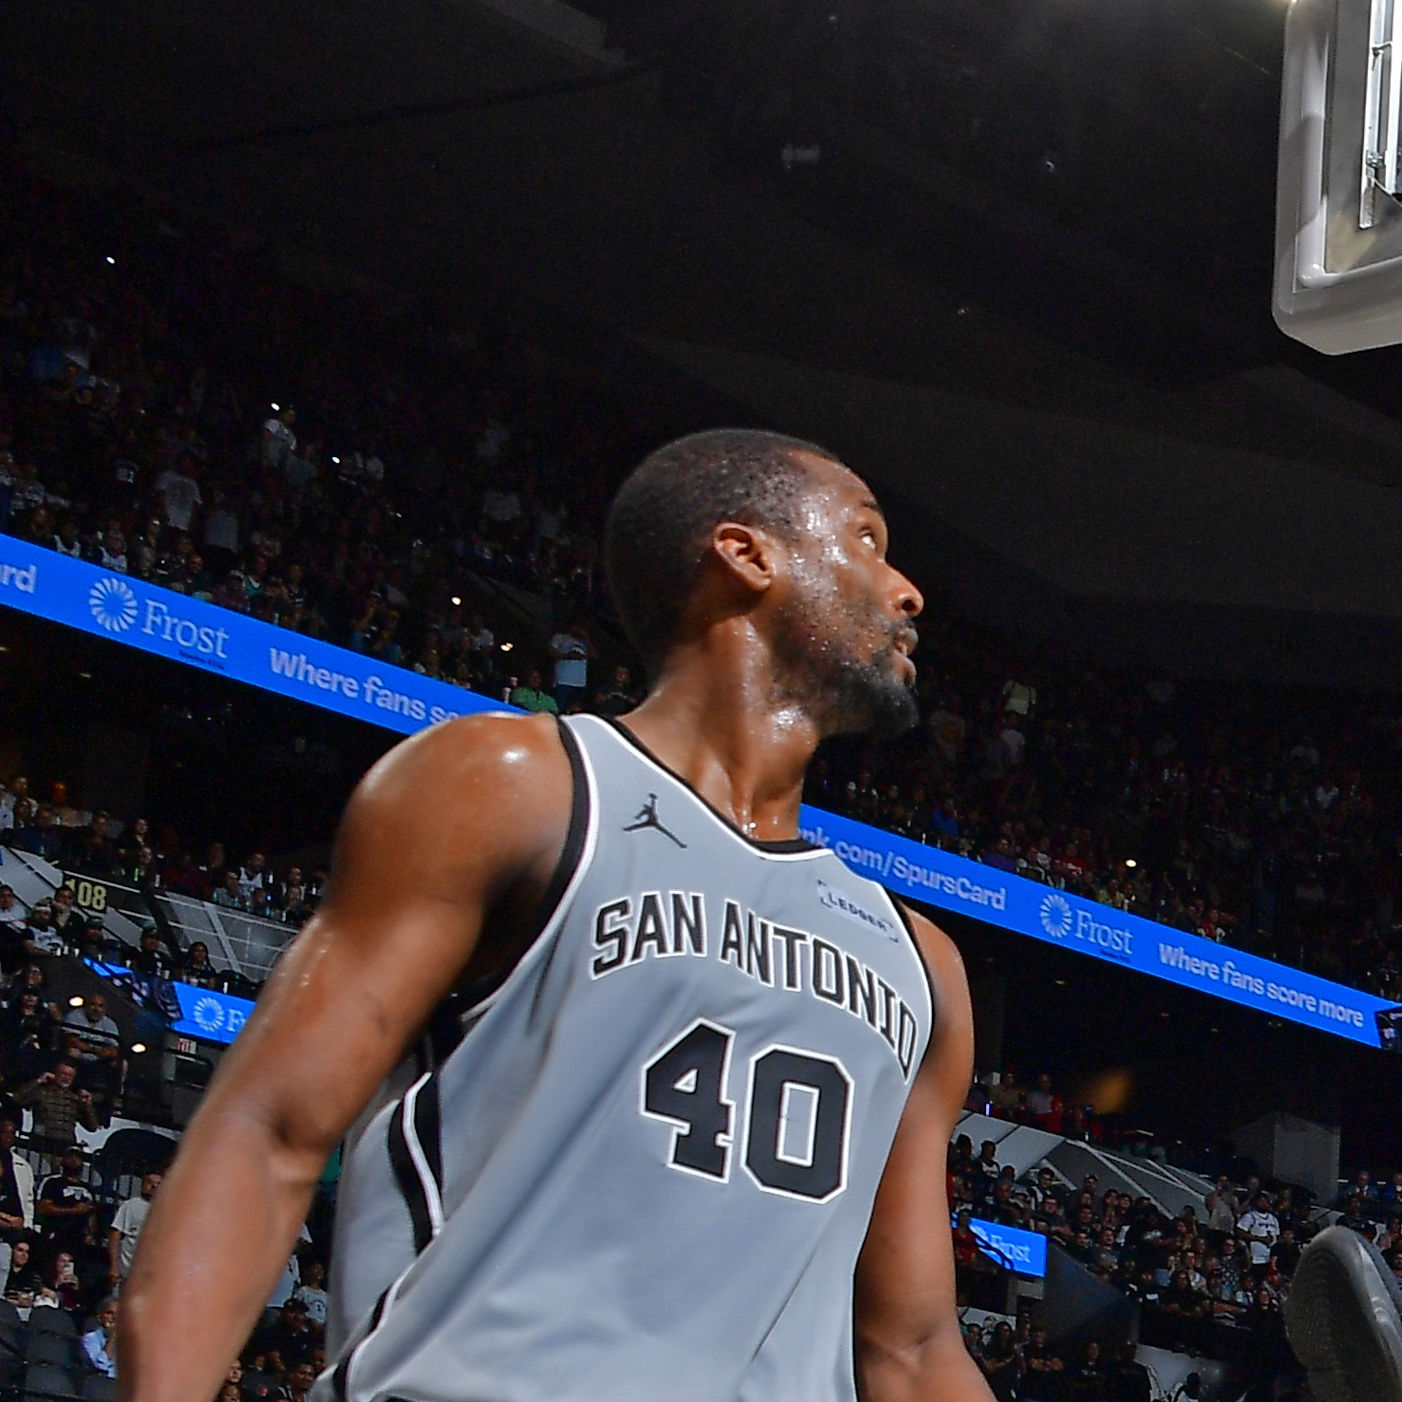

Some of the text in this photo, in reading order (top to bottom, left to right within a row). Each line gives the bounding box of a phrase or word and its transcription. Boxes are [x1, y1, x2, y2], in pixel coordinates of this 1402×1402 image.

[0, 564, 38, 594] rd
[141, 598, 230, 659] Frost
[270, 647, 360, 699] Where
[363, 676, 427, 721] fans
[827, 892, 888, 931] LEDGER
[1075, 909, 1133, 954] Frost
[591, 890, 918, 1085] SAN ANTONIO
[1158, 942, 1219, 980] Where
[1221, 960, 1265, 995] fans
[1266, 983, 1317, 1012] score
[1318, 999, 1364, 1027] more
[639, 1017, 855, 1204] 40
